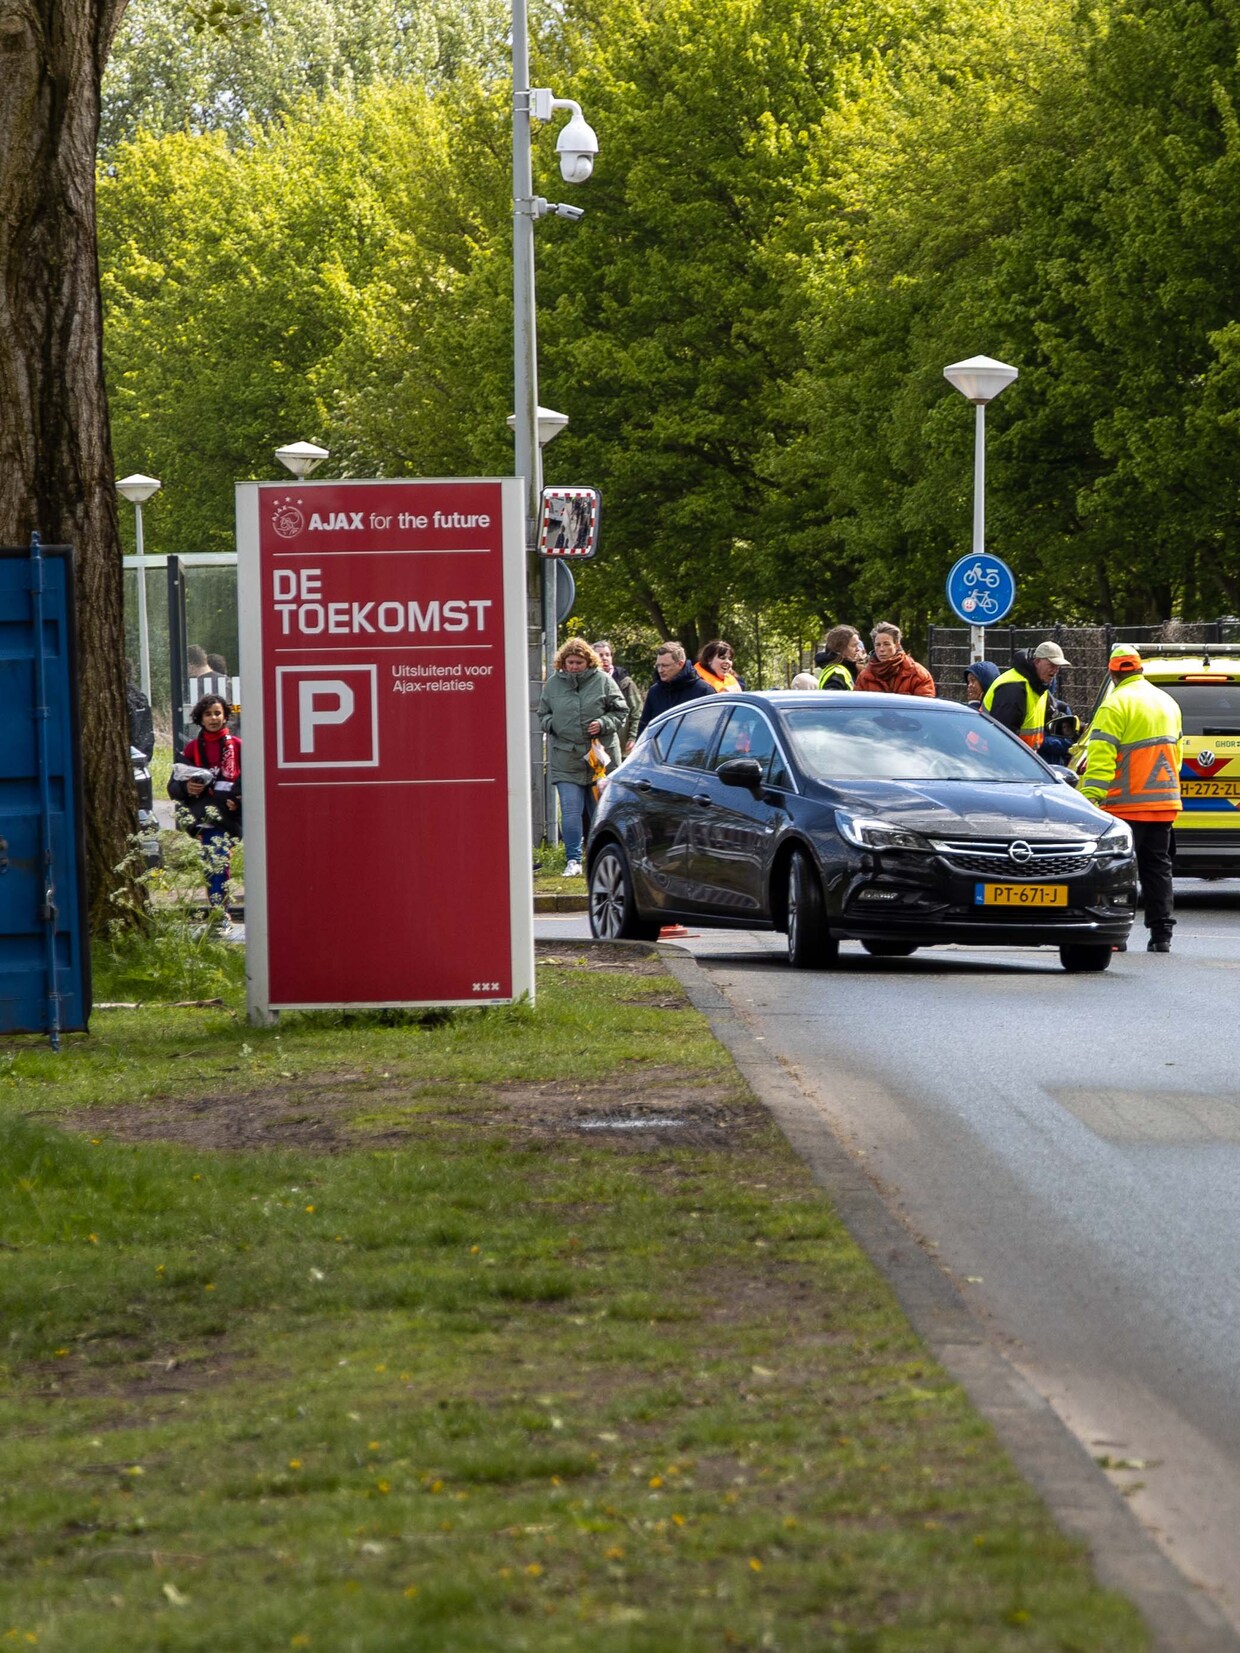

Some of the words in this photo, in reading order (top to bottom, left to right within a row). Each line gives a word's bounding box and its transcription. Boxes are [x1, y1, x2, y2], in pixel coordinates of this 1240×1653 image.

[308, 512, 364, 531] AJAX
[369, 513, 392, 530] for
[398, 512, 428, 529] the
[433, 511, 490, 528] future
[272, 568, 322, 601] DE
[273, 600, 493, 635] TOEKOMST
[391, 664, 462, 677] Uitsluitend
[464, 665, 493, 676] voor
[392, 679, 475, 695] Ajax-relaties
[298, 680, 355, 754] P
[1215, 740, 1236, 748] GHOR
[1181, 783, 1240, 796] H-272-ZL
[993, 887, 1058, 903] PT-671-J
